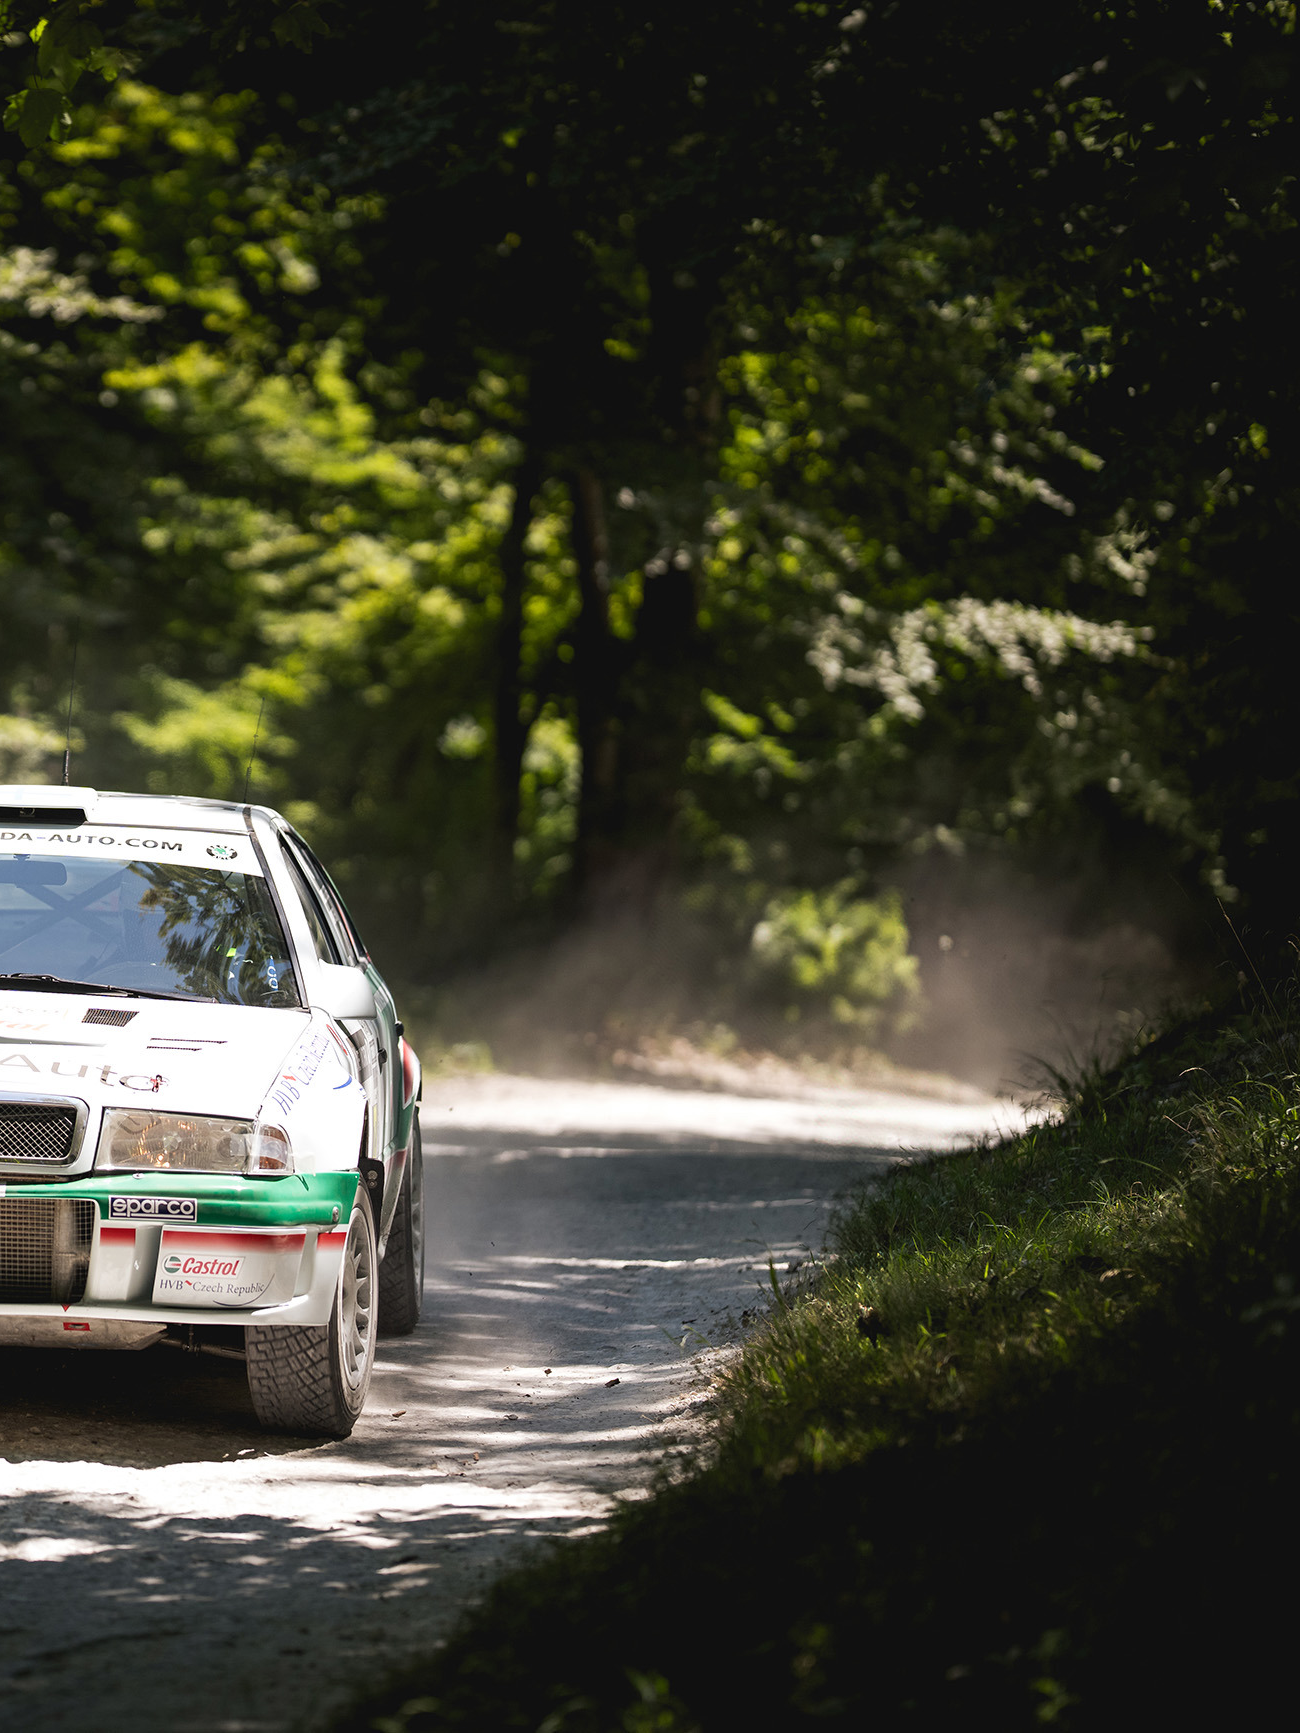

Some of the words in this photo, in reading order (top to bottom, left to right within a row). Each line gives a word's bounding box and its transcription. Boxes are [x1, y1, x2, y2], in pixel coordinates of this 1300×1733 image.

[112, 1198, 195, 1218] sparco
[181, 1256, 240, 1277] Castrol
[159, 1278, 184, 1291] HVB
[192, 1280, 223, 1294] Czech
[226, 1283, 265, 1297] Republic
